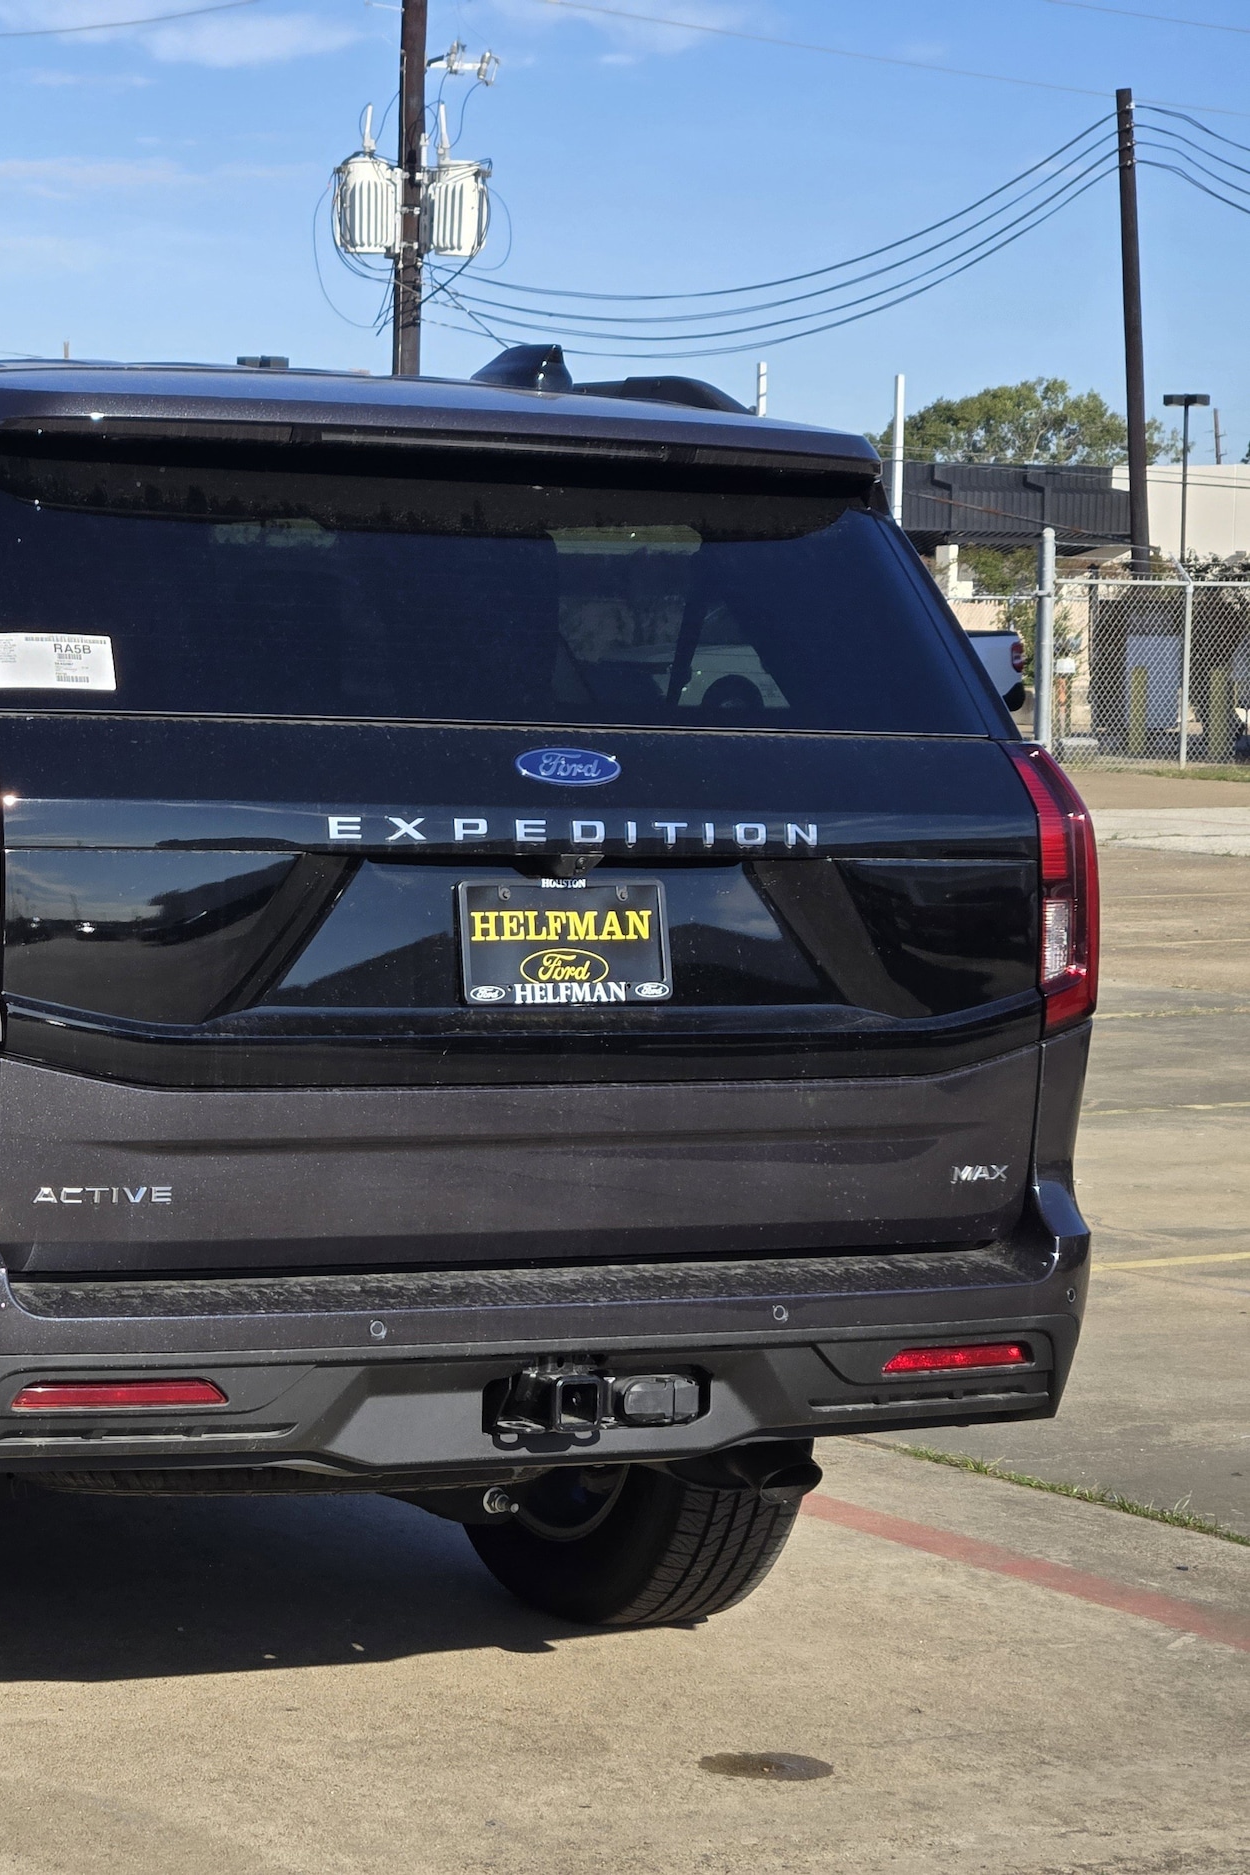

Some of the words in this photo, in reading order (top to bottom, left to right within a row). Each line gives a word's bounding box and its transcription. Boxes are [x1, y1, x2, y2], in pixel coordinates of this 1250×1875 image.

[53, 643, 91, 654] RA5B
[539, 750, 601, 777] Ford
[327, 815, 819, 846] EXPEDITION
[541, 878, 587, 889] HOUSTON
[470, 910, 652, 941] HELFMAN
[537, 953, 591, 981] Ford
[514, 981, 626, 1004] HELFMAN
[951, 1164, 1009, 1181] MAX
[32, 1186, 173, 1204] ACTIVE
